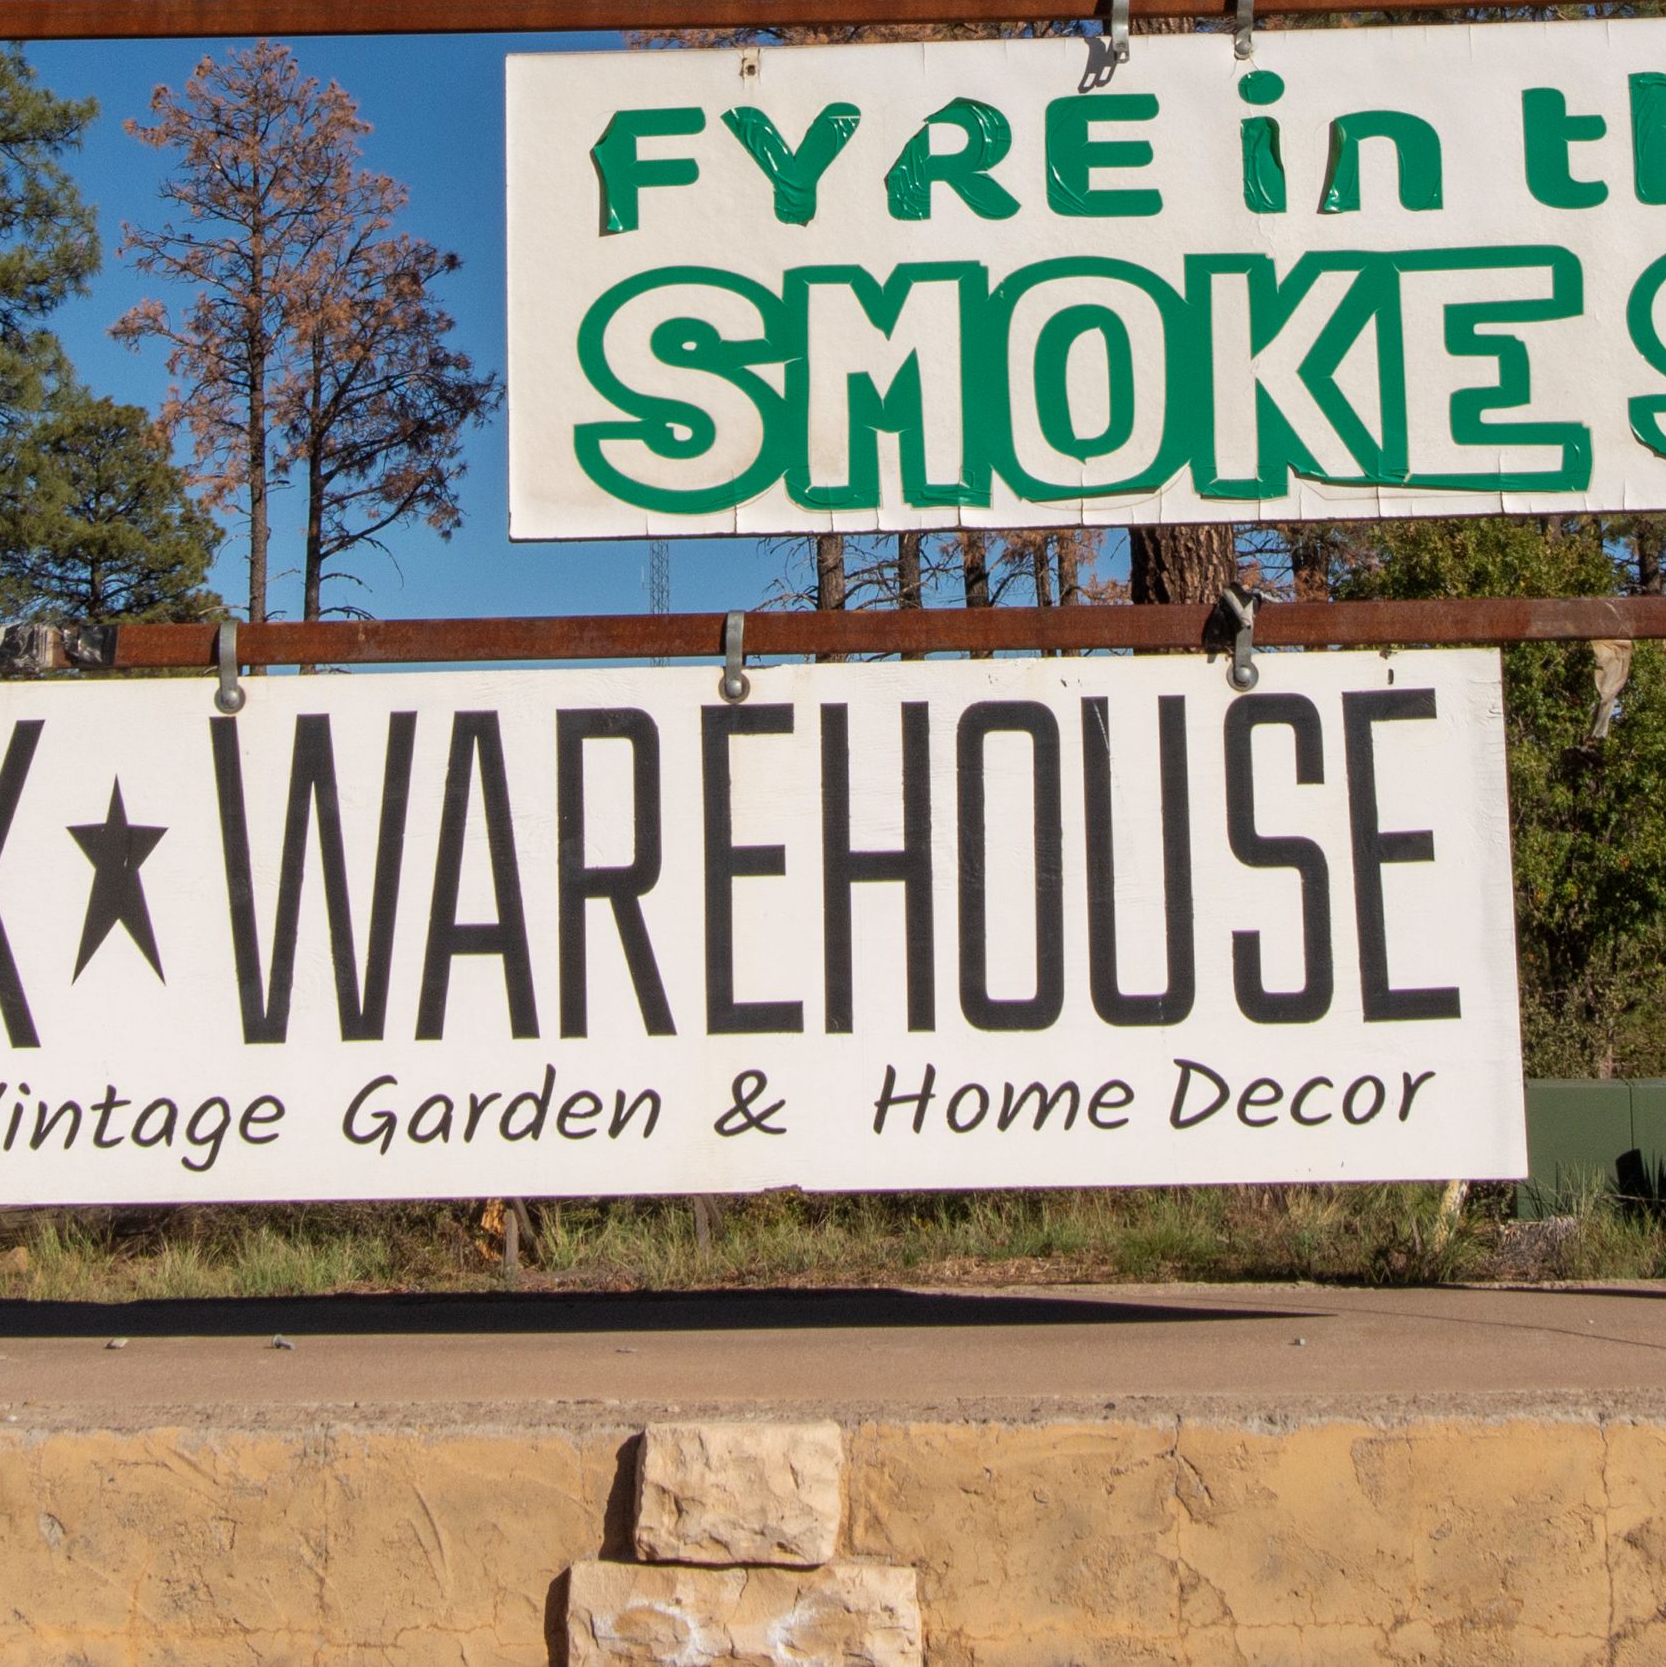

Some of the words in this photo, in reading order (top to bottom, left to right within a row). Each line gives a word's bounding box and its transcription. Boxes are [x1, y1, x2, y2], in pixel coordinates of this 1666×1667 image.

[594, 94, 1162, 232] FYRE
[1240, 71, 1442, 213] in
[575, 246, 1592, 514] SMOKE
[210, 689, 1460, 1043] WAREHOUSE
[344, 1065, 660, 1154] Garden
[715, 1072, 786, 1136] &
[874, 1065, 1133, 1133] Home
[1171, 1060, 1434, 1128] Decor
